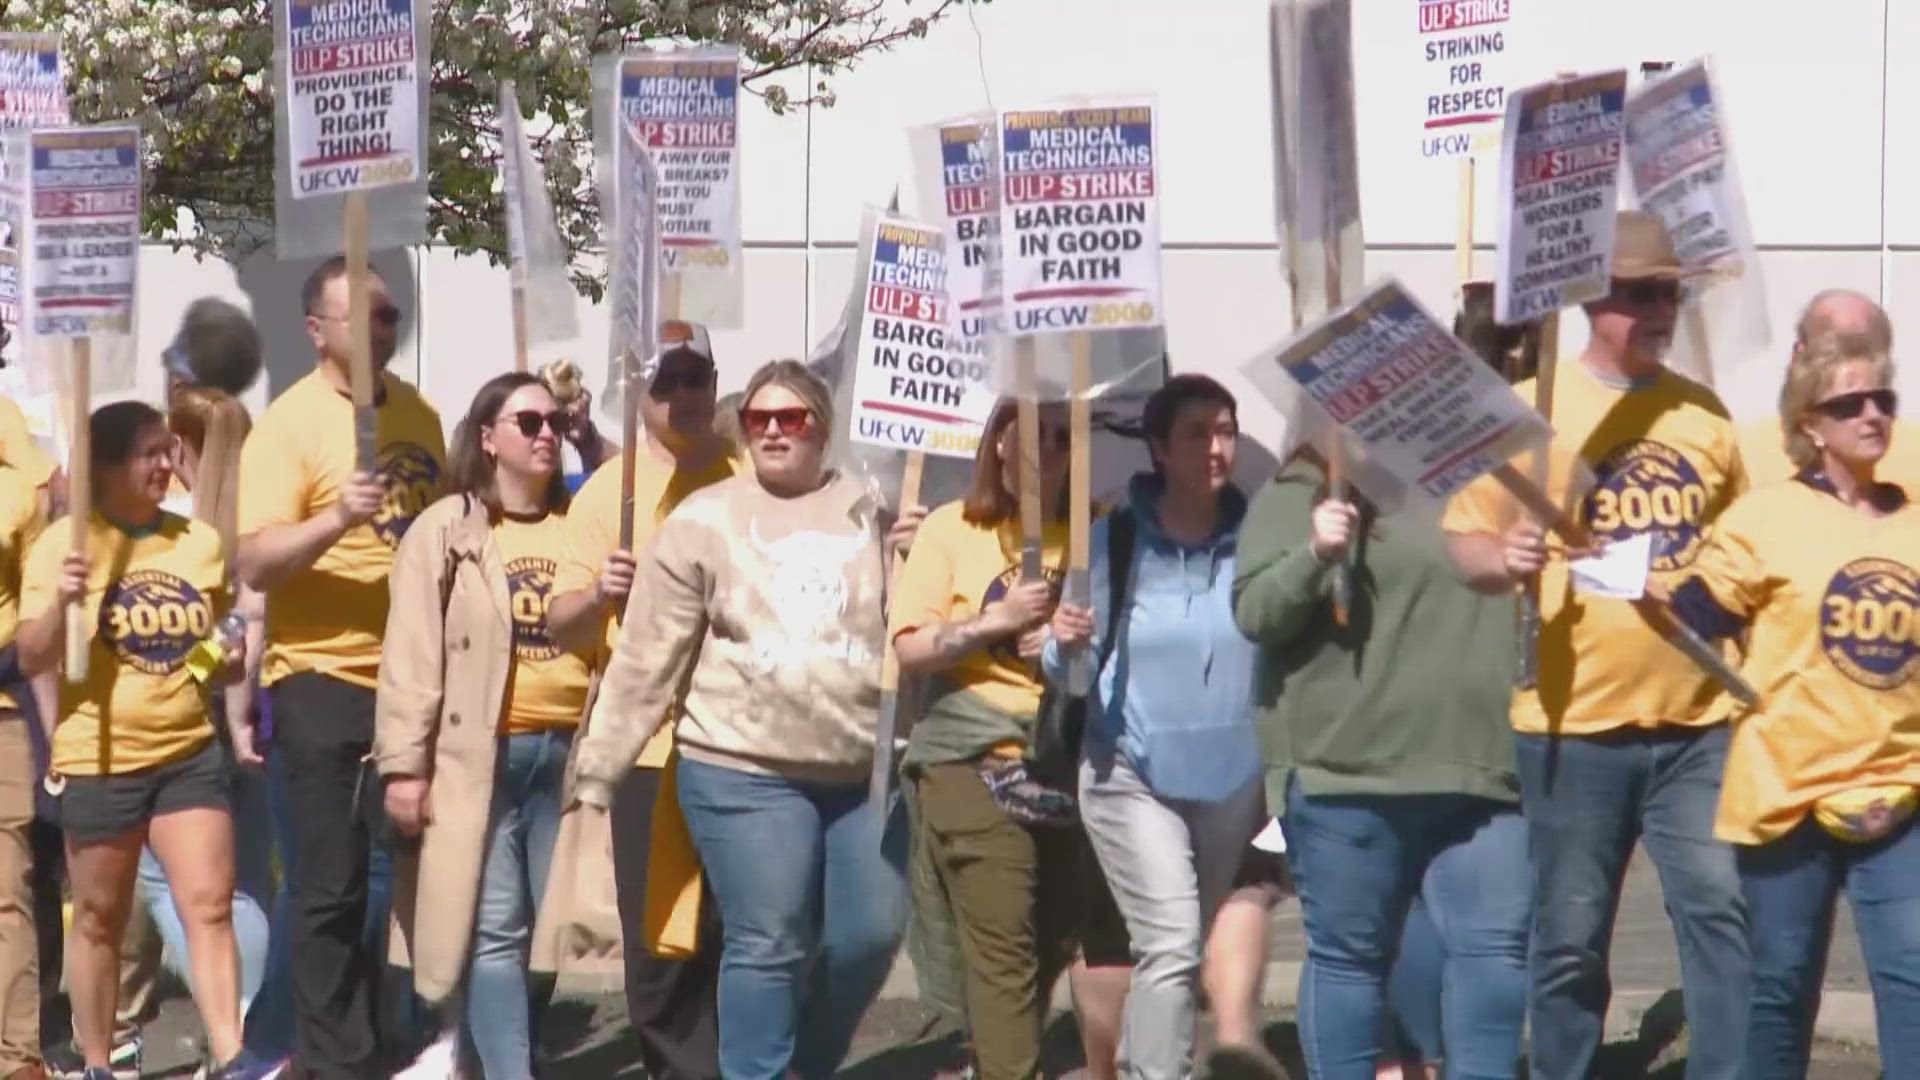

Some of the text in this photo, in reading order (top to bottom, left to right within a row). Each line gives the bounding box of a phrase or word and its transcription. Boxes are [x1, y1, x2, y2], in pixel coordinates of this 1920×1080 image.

[311, 0, 391, 23] MEDICAL
[1421, 0, 1508, 30] ULP STRIKE
[292, 13, 410, 46] TECHNICIANS
[294, 36, 411, 73] ULP STRIKE
[1426, 31, 1504, 61] STRIKING
[295, 66, 413, 95] PROVIDENCE,
[639, 77, 716, 96] MEDICAL
[1450, 63, 1481, 85] FOR
[314, 87, 392, 115] DO THE
[622, 97, 734, 118] TECHNICIANS
[1428, 87, 1504, 115] RESPECT
[321, 110, 387, 135] RIGHT
[662, 120, 733, 145] STRIKE
[317, 132, 391, 158] THING!
[1030, 126, 1126, 149] MEDICAL
[1422, 134, 1470, 157] UFCW
[659, 151, 731, 164] AWAY OUR
[1006, 144, 1150, 171] TECHNICIANS
[664, 167, 729, 182] BREAKS?
[1009, 174, 1054, 201] ULP
[1060, 170, 1151, 197] STRIKE
[684, 185, 710, 198] YOU
[1015, 202, 1146, 229] BARGAIN
[1020, 229, 1142, 257] IN GOOD
[1042, 257, 1120, 282] FAITH
[873, 287, 914, 316] ULP
[873, 345, 984, 383] IN GOOD
[890, 375, 961, 407] FAITH
[1592, 484, 1705, 531] 3000
[109, 602, 210, 639] 3000
